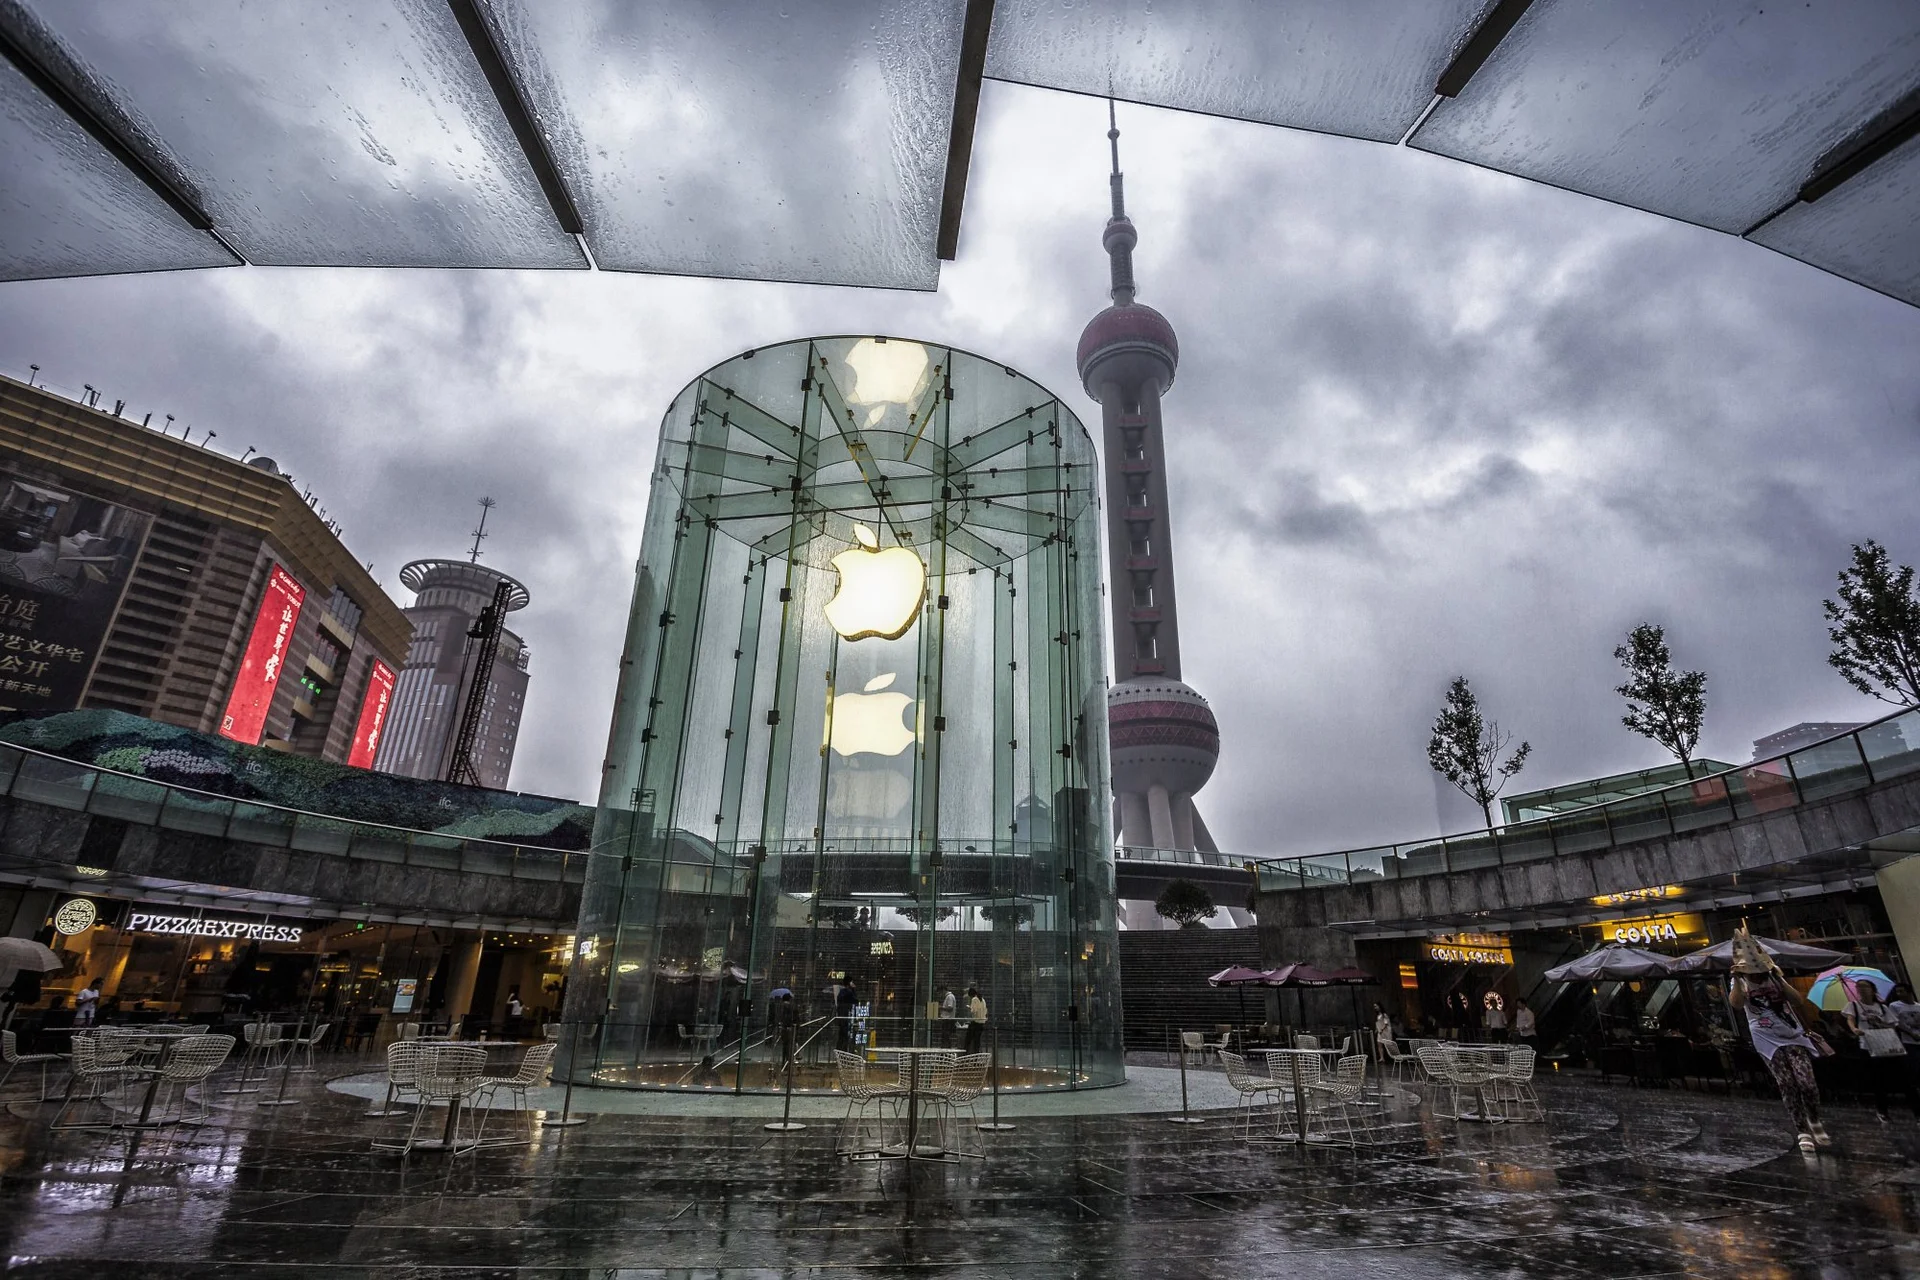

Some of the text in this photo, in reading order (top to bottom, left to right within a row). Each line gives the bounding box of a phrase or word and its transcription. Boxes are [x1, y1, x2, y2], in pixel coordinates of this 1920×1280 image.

[0, 679, 52, 697] 新天地
[1615, 924, 1677, 944] COSTA
[1431, 948, 1466, 962] COSTA
